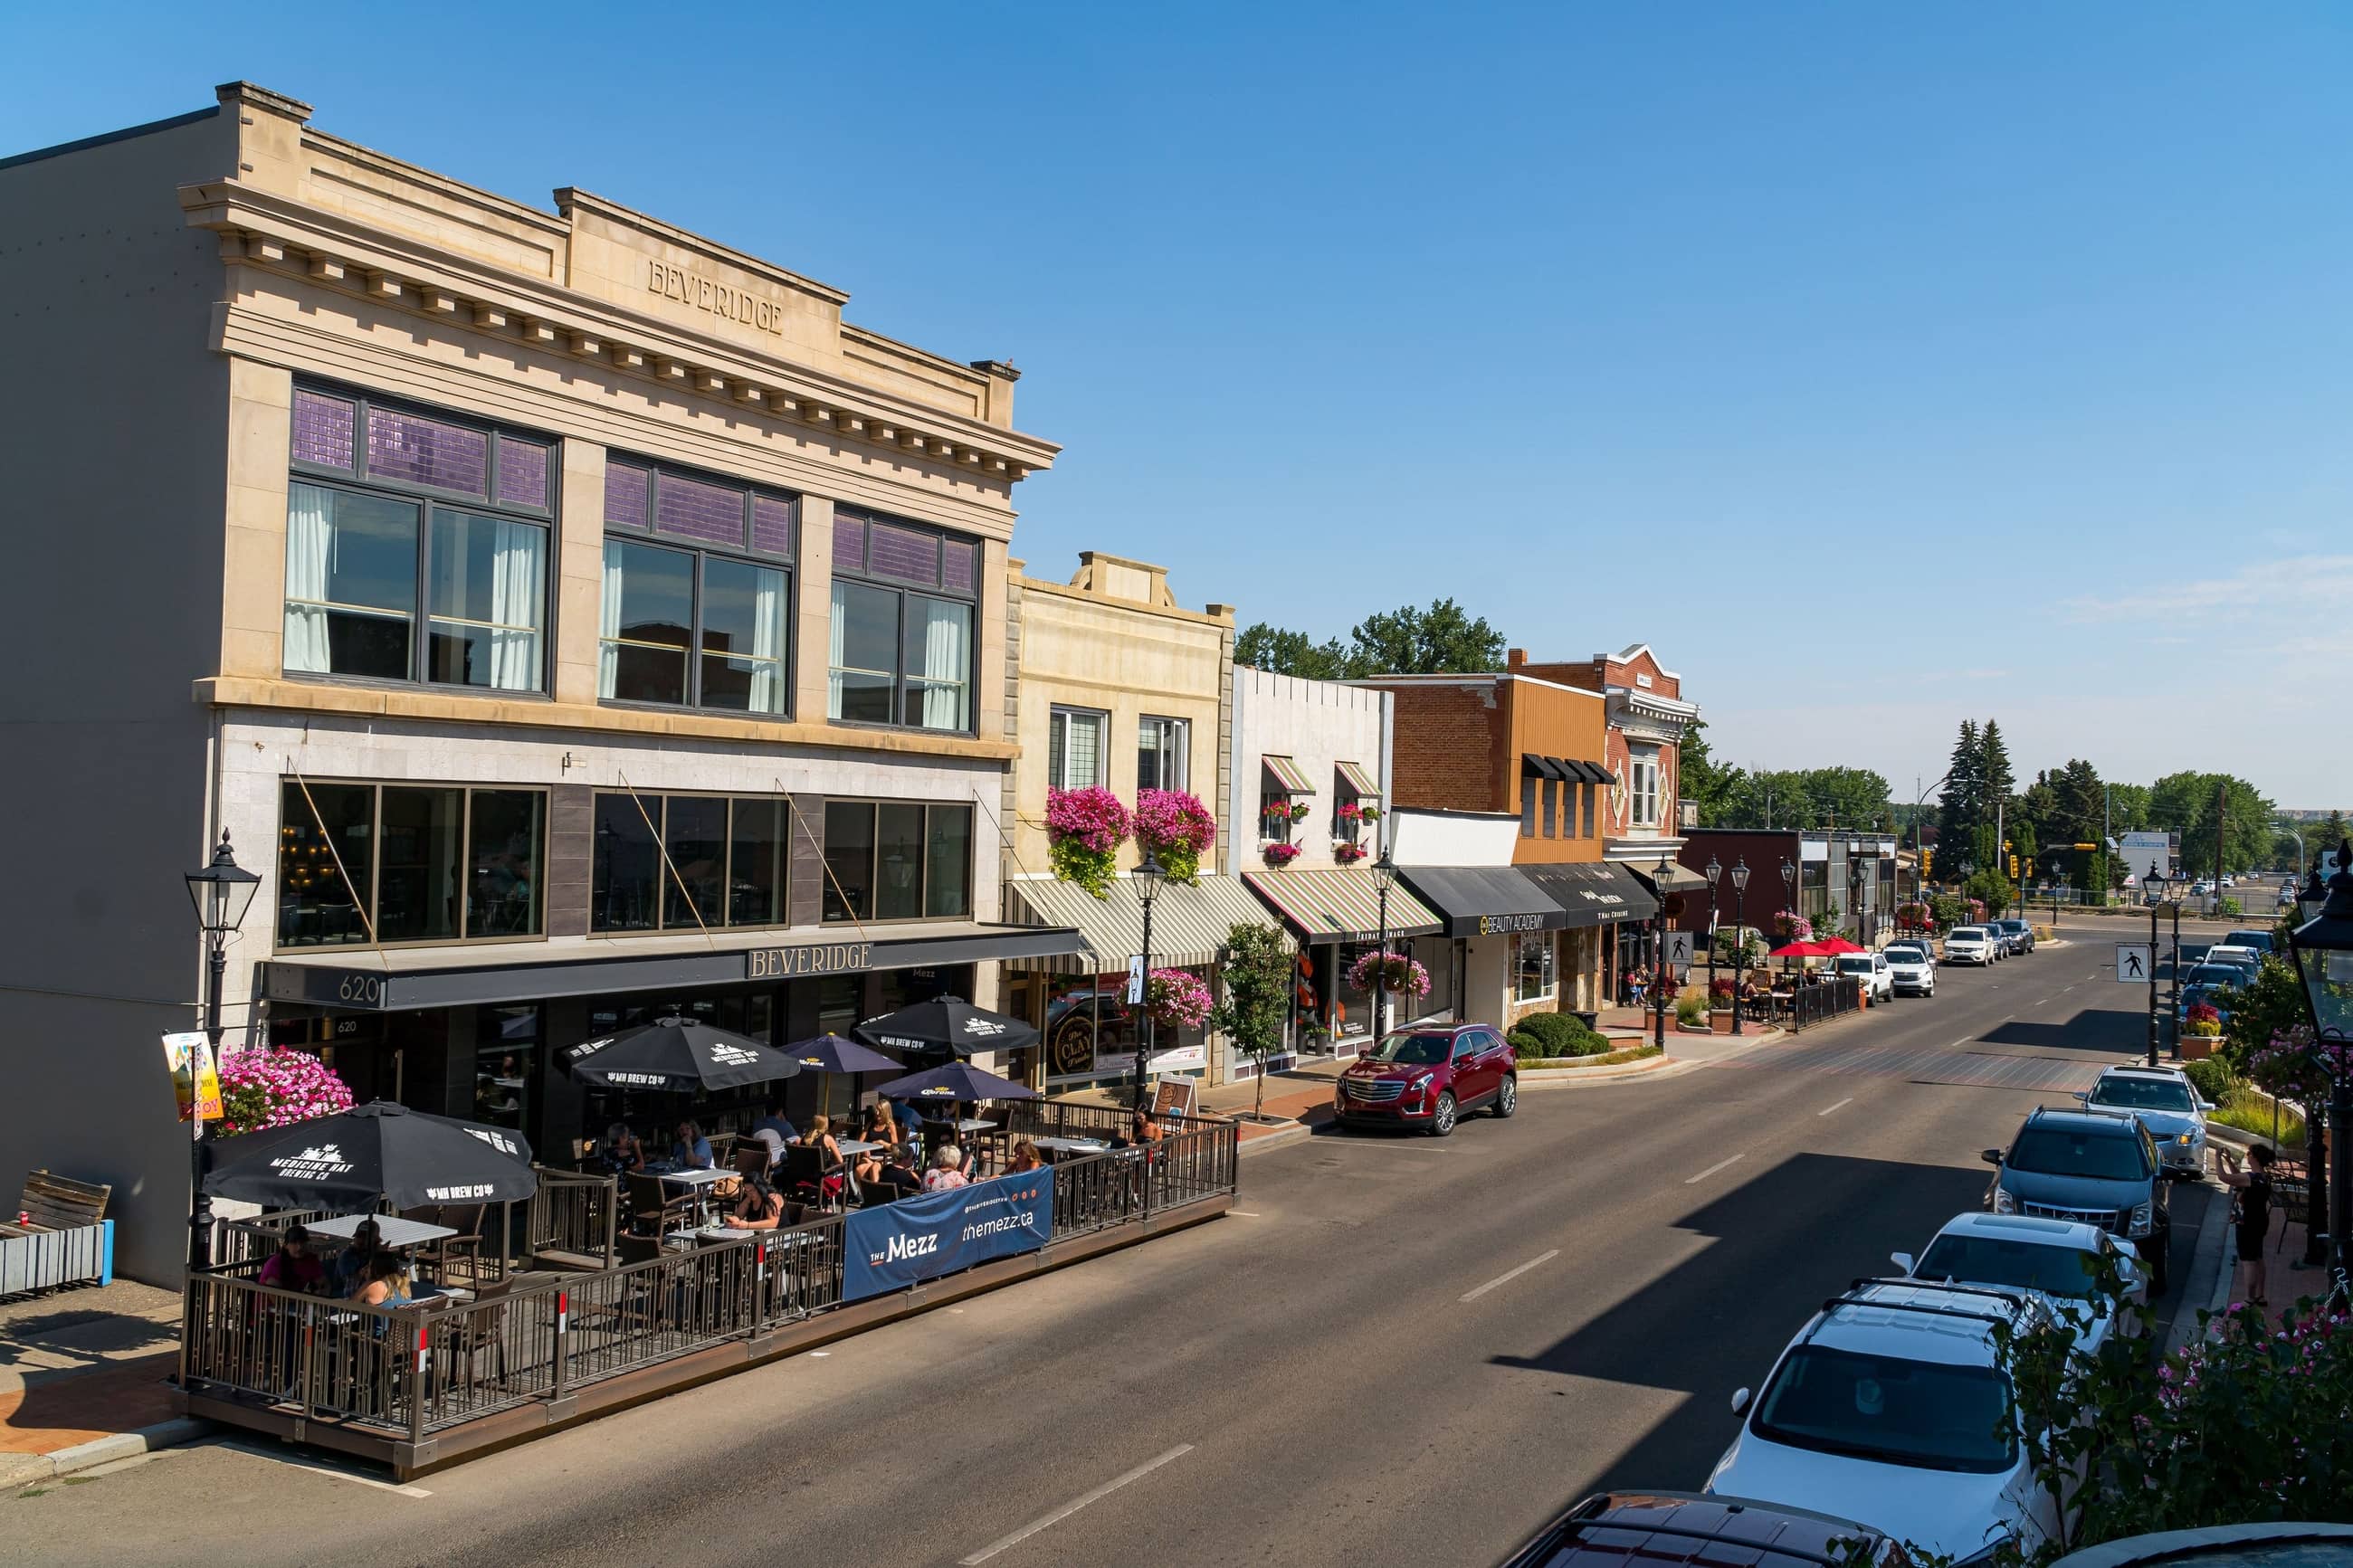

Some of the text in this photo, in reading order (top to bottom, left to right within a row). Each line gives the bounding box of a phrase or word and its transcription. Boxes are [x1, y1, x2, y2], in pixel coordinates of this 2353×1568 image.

[648, 260, 783, 336] BEVERIDGE
[1488, 916, 1513, 934] BEAUTY
[1513, 914, 1544, 931] ACADEMY
[751, 944, 873, 977] BEVERIDGE
[339, 974, 379, 1003] 620
[338, 1020, 357, 1033] 620
[895, 1037, 910, 1047] BREW
[1062, 1033, 1091, 1060] CLAY
[615, 1073, 657, 1085] MH BREW CO
[921, 1088, 956, 1097] Corona
[270, 1158, 354, 1173] MEDICINE HAT
[316, 1172, 330, 1181] CO
[450, 1186, 472, 1199] BREW
[473, 1184, 484, 1197] CO
[963, 1211, 1034, 1242] themezz.ca
[870, 1233, 938, 1263] THE Mezz
